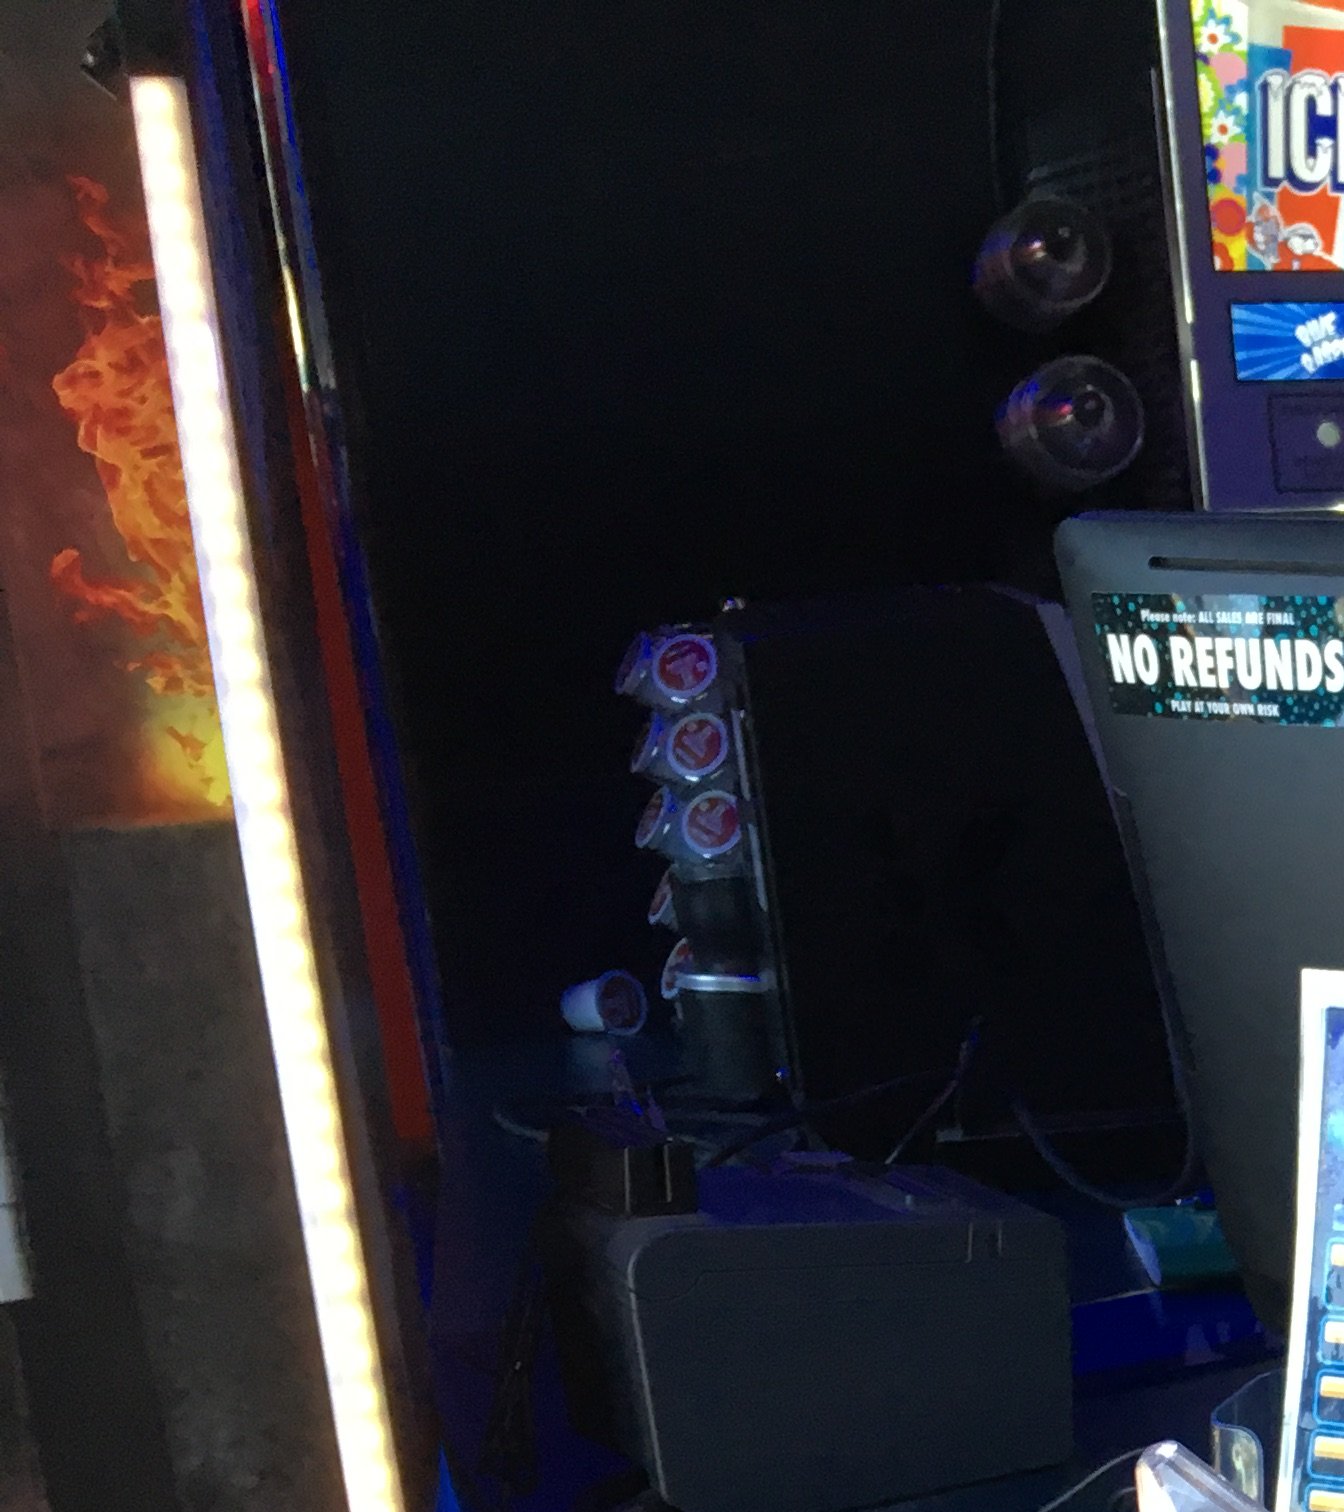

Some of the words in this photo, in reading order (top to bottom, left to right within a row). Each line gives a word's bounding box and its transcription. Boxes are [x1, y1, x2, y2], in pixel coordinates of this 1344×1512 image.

[1140, 608, 1170, 622] Please
[1174, 610, 1196, 624] note:
[1199, 611, 1214, 624] ALL
[1216, 611, 1241, 625] SALES
[1245, 612, 1263, 625] ARE
[1266, 612, 1295, 627] FINAL
[1106, 633, 1160, 686] NO
[1171, 700, 1192, 713] PLAY
[1194, 700, 1204, 713] AT
[1205, 701, 1230, 715] YOUR
[1232, 702, 1255, 716] OWN
[1257, 703, 1281, 717] RISK
